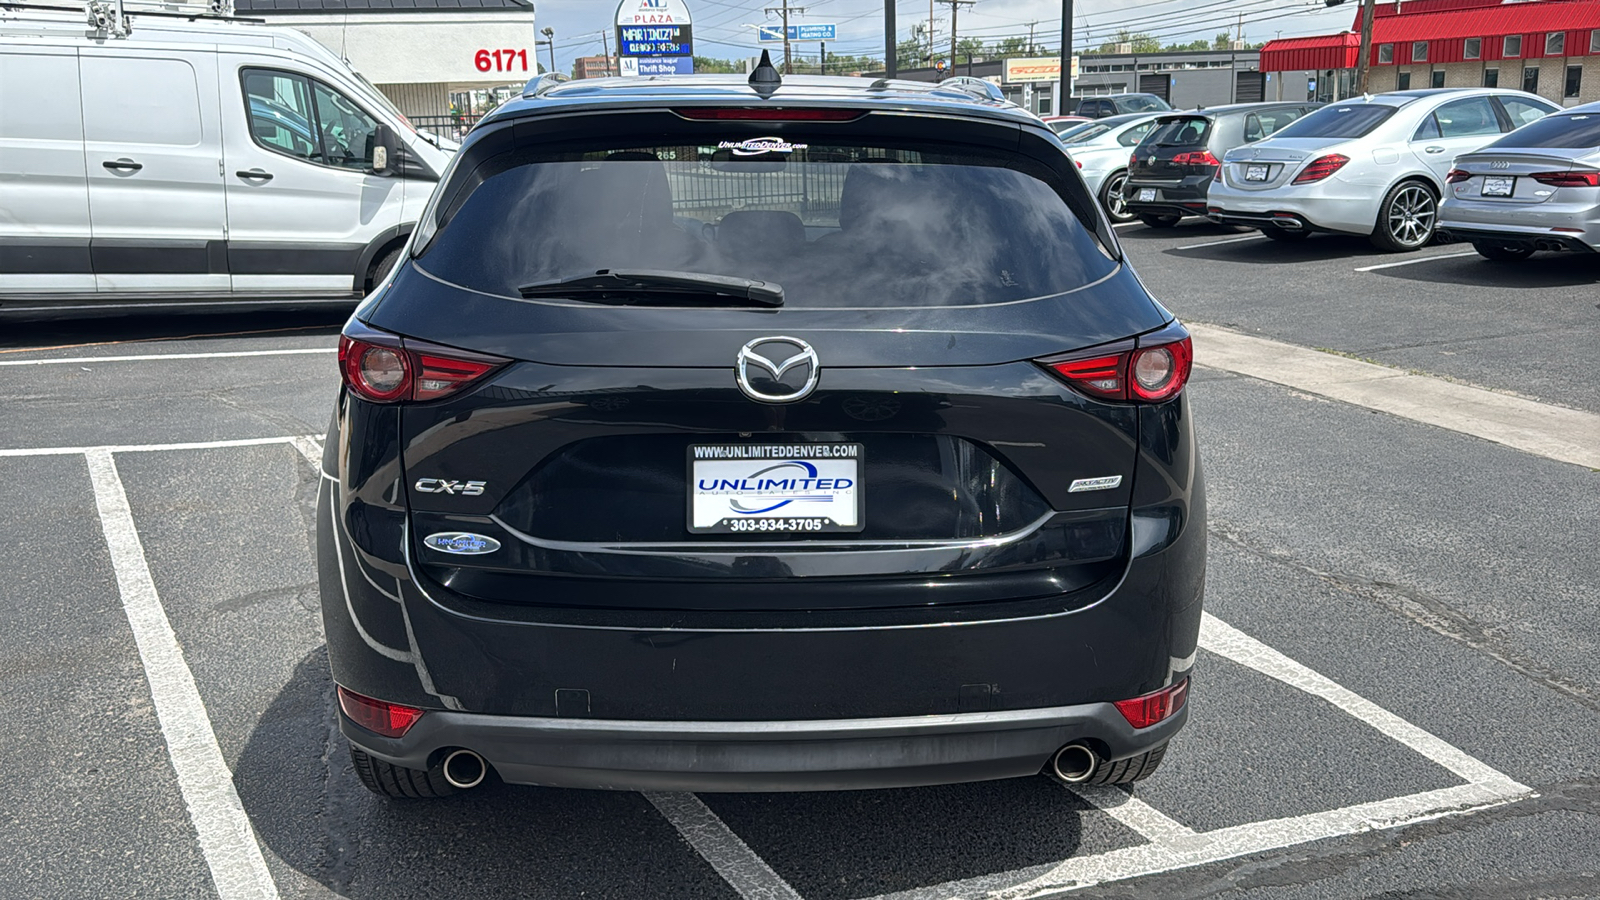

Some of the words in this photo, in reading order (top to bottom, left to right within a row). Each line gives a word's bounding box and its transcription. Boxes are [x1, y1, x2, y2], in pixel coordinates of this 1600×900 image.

[634, 14, 673, 23] PLAZA
[474, 49, 529, 72] 6171
[639, 65, 658, 73] Thrift
[658, 65, 676, 74] Shop
[414, 478, 487, 496] CX-5
[699, 478, 853, 490] UNLIMITED
[730, 518, 822, 531] 303-934-3705
